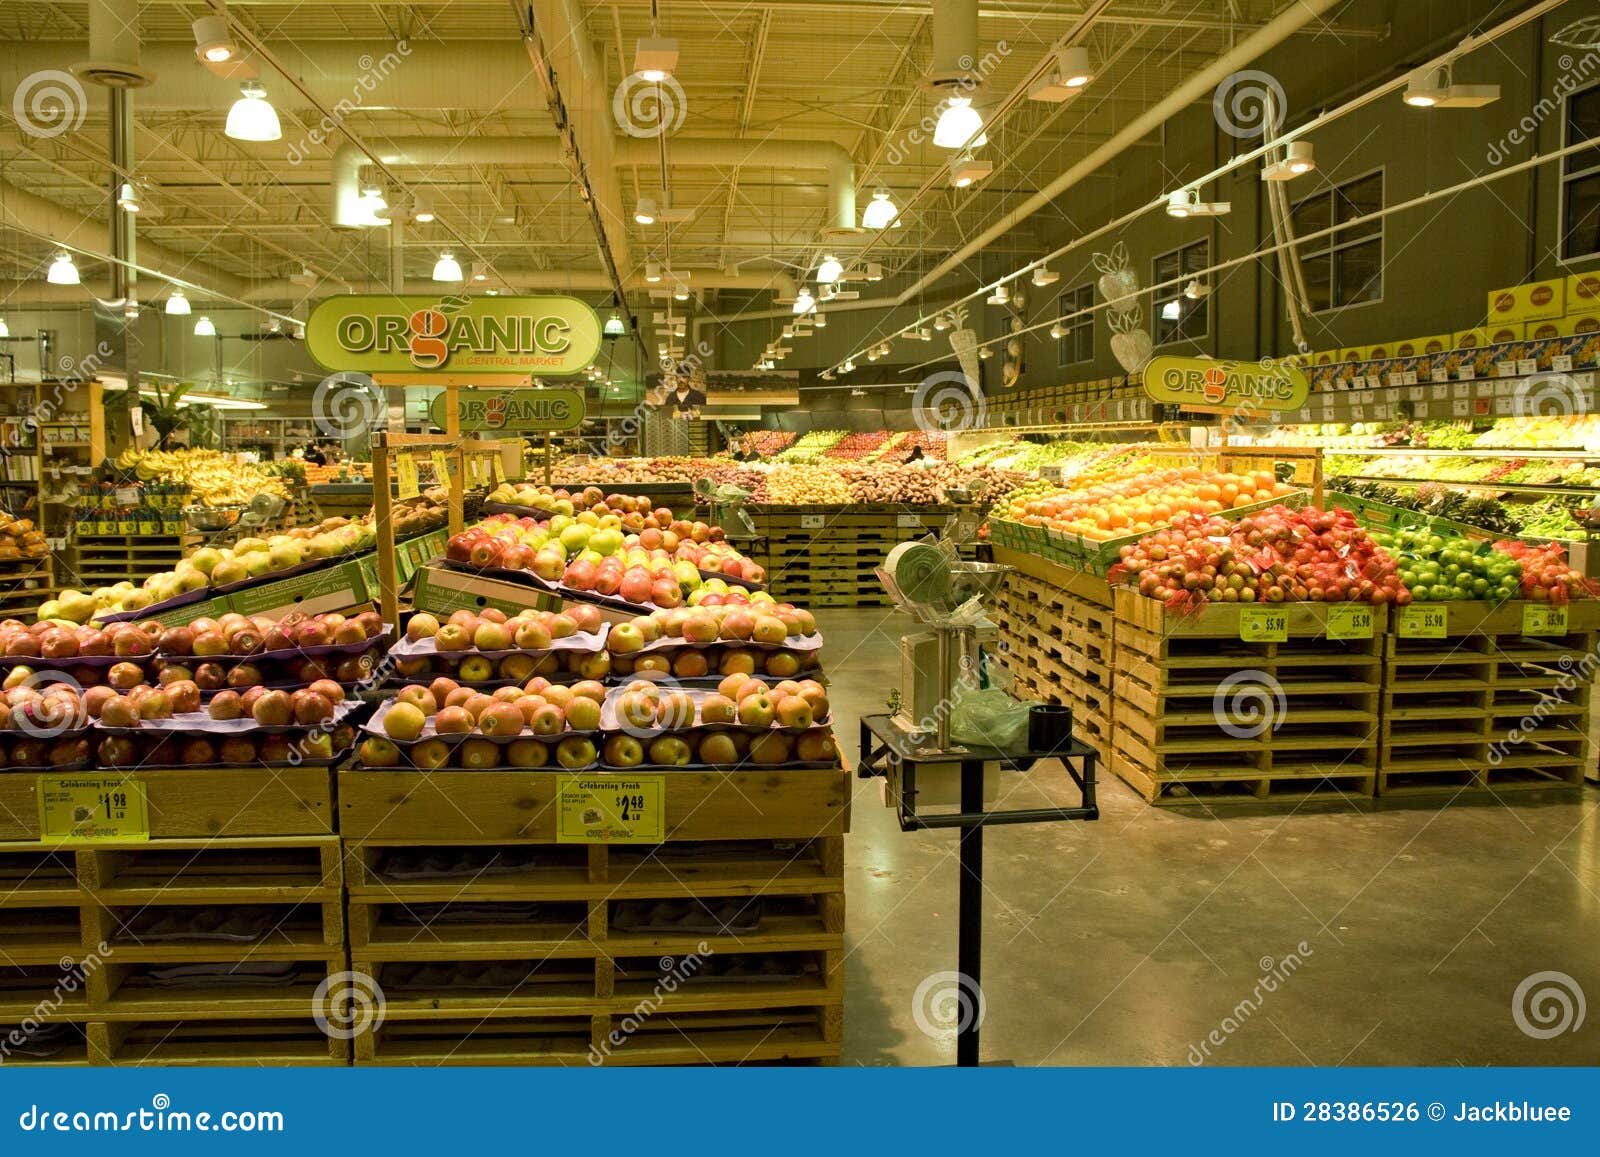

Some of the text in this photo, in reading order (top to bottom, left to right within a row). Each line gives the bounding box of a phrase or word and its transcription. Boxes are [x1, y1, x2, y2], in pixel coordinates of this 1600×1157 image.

[337, 309, 571, 368] ORgANIC
[467, 357, 517, 366] CENTRAL
[519, 357, 564, 366] MARKET
